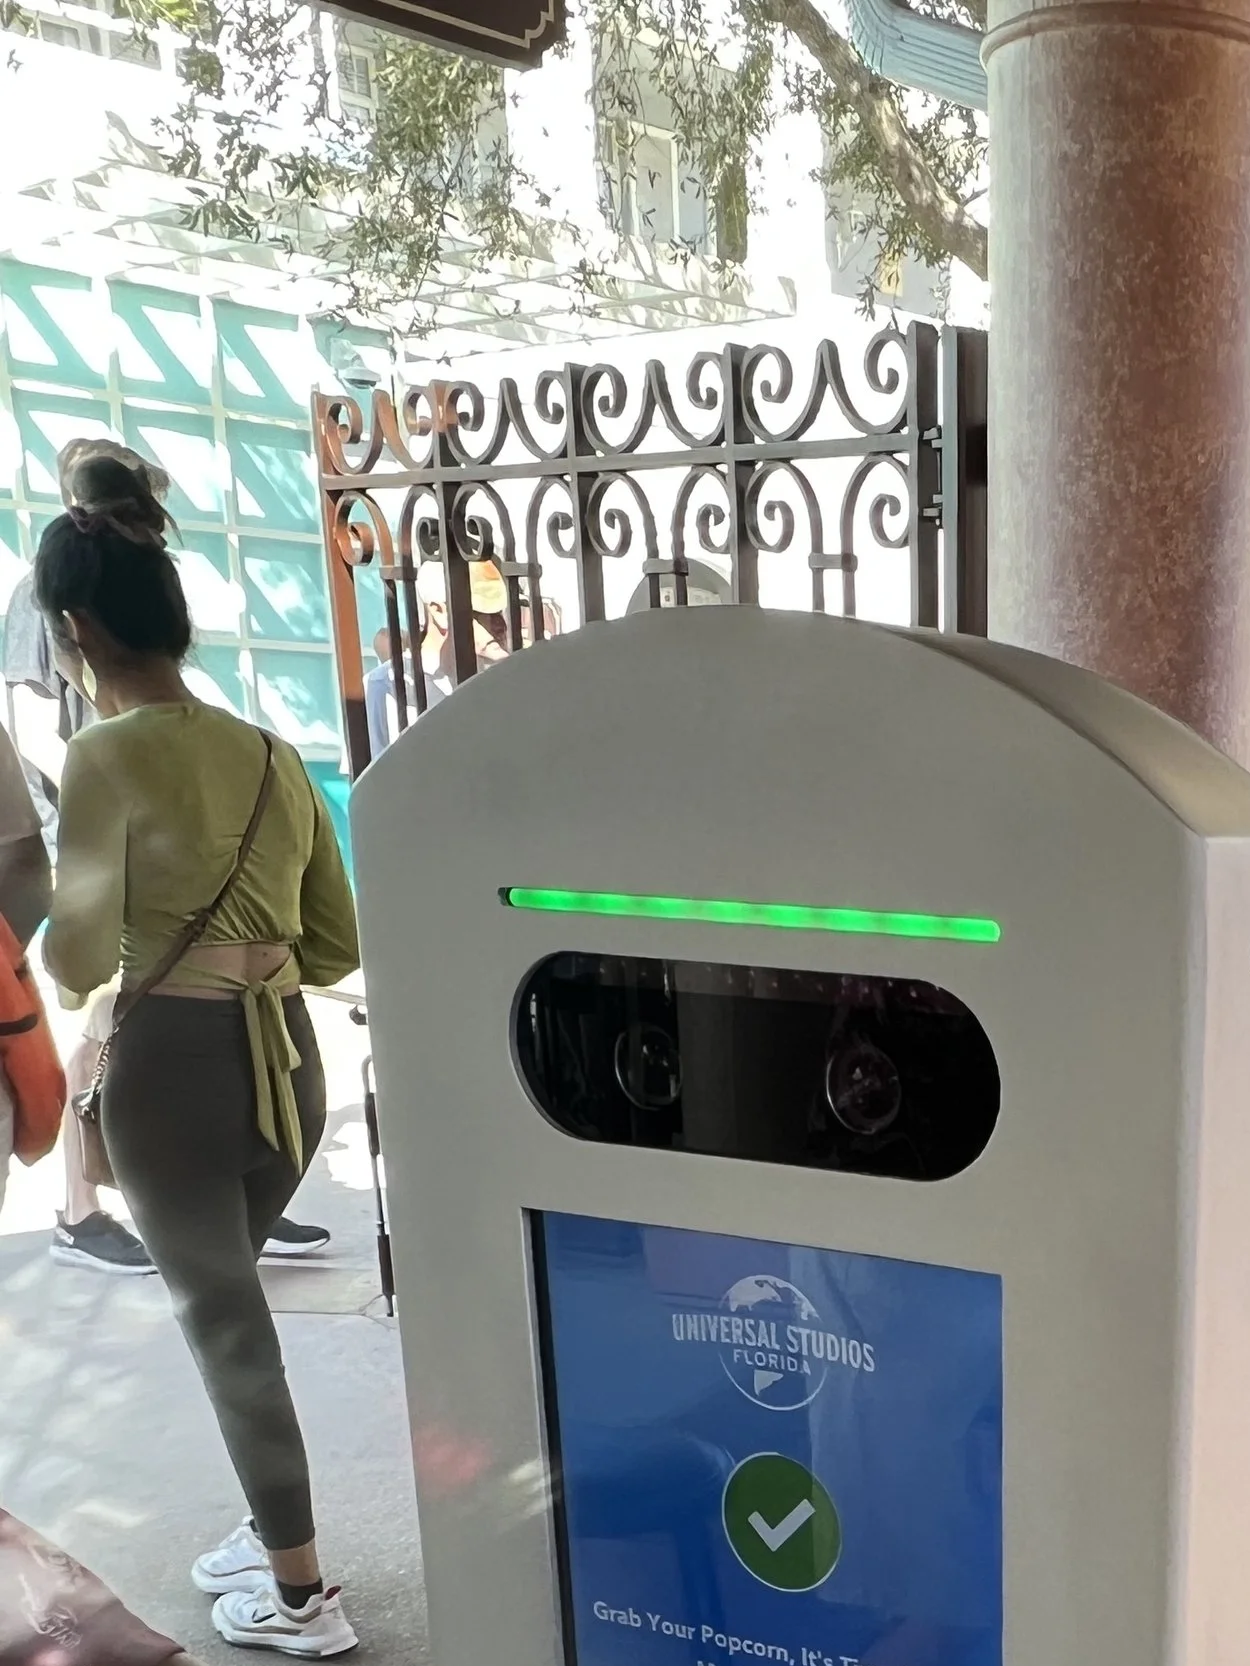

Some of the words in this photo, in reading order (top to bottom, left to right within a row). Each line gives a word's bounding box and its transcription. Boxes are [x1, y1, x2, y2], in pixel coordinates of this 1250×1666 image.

[672, 1313, 781, 1351] UNIVERSAL
[786, 1324, 876, 1373] STUDIOS
[733, 1348, 812, 1376] FLORIDA
[593, 1600, 643, 1628] Grab
[646, 1611, 696, 1641] Your
[701, 1624, 796, 1666] Popcorn,
